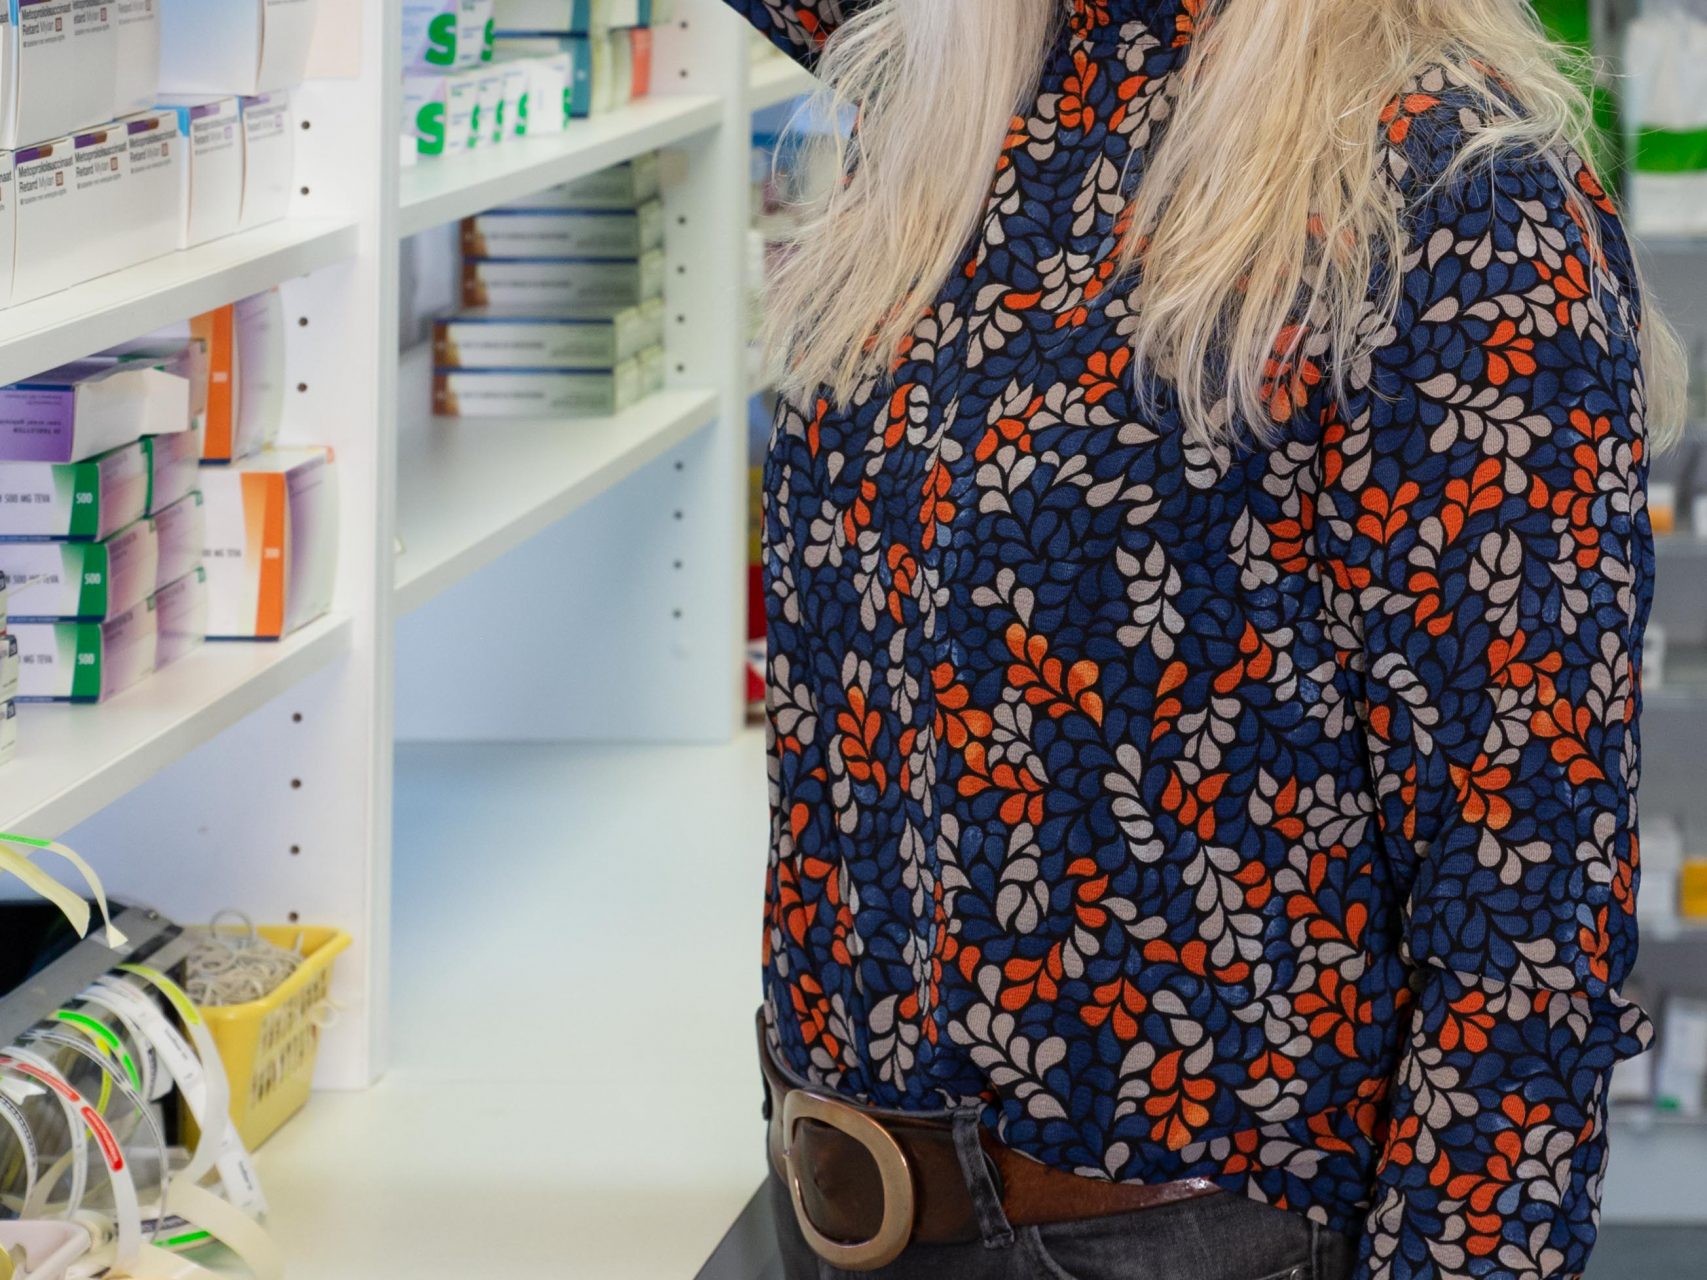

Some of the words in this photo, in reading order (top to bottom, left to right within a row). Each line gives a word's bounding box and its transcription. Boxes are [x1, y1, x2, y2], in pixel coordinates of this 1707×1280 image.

[75, 492, 93, 505] 500
[84, 572, 101, 585] 500
[78, 652, 96, 665] 500
